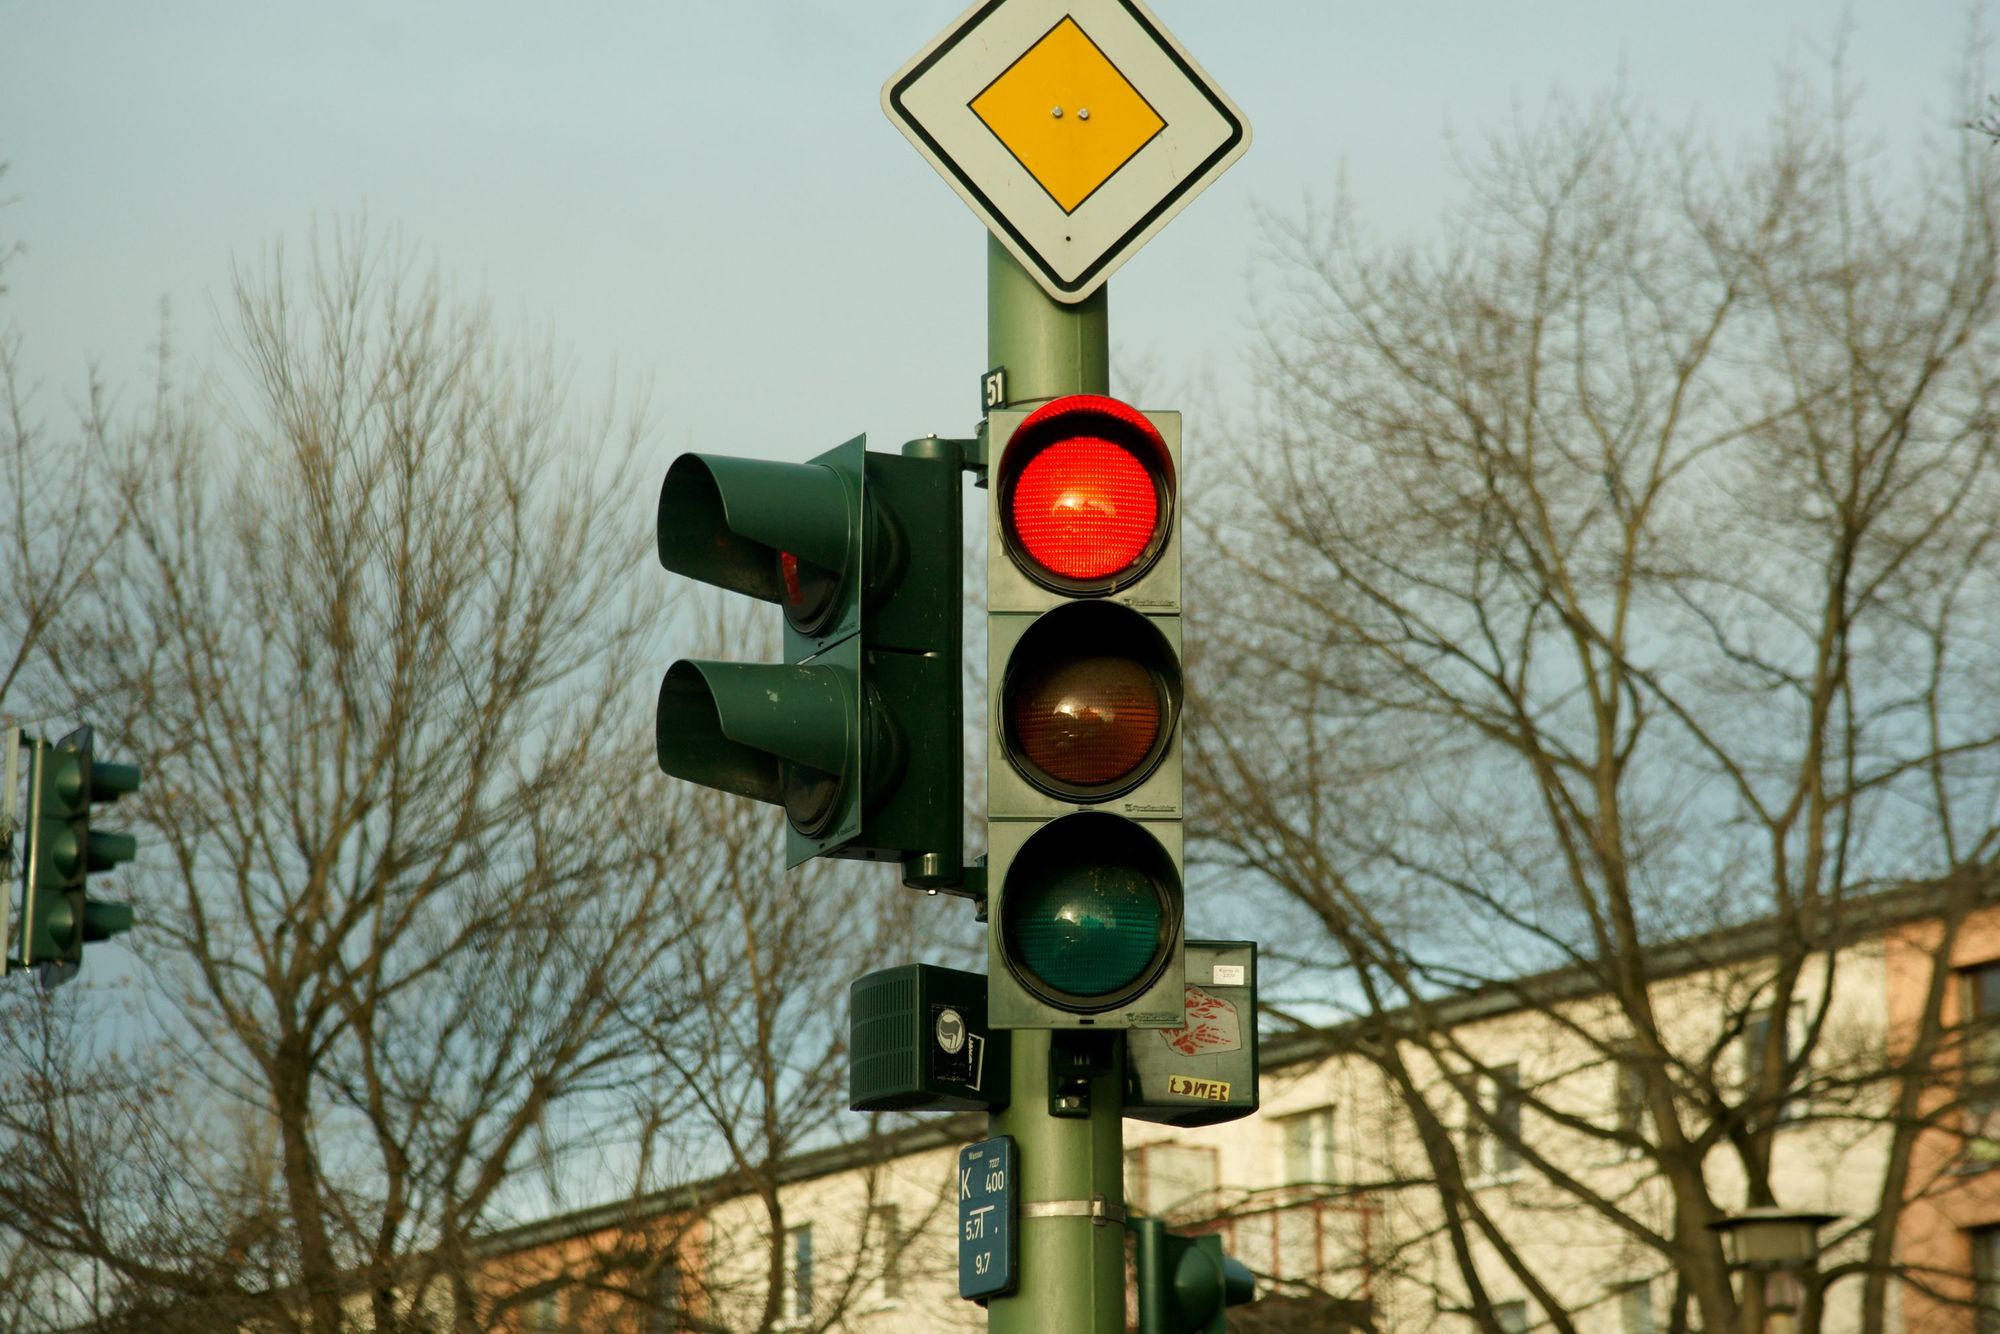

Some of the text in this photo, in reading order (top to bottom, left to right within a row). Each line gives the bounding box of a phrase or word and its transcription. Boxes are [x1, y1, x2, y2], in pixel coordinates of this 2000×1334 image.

[987, 372, 1002, 406] 51
[961, 1167, 1004, 1200] K 400
